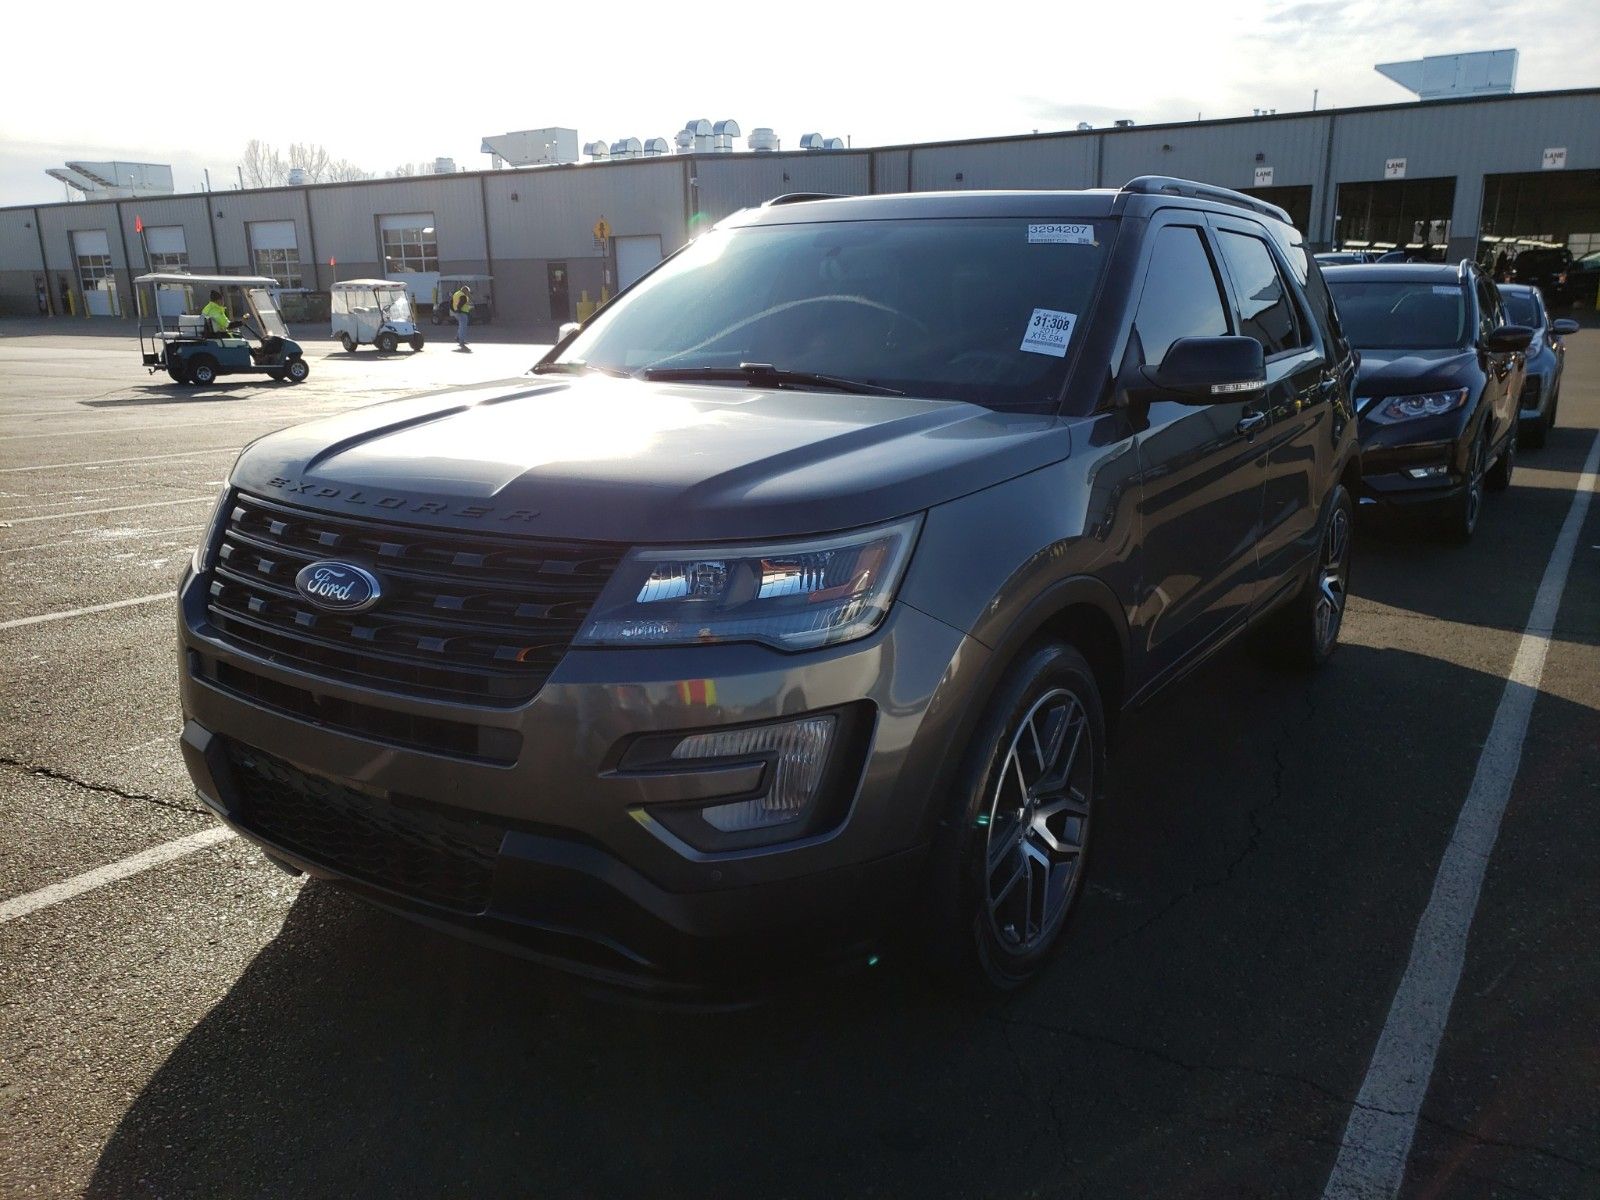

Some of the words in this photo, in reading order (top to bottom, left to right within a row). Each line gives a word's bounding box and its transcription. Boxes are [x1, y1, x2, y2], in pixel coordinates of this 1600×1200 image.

[1386, 161, 1404, 169] LANE
[1029, 225, 1088, 234] 3294207
[1033, 315, 1070, 331] 31:308
[1039, 327, 1061, 335] 2017
[266, 477, 541, 521] EXPLORER
[307, 568, 356, 600] Ford
